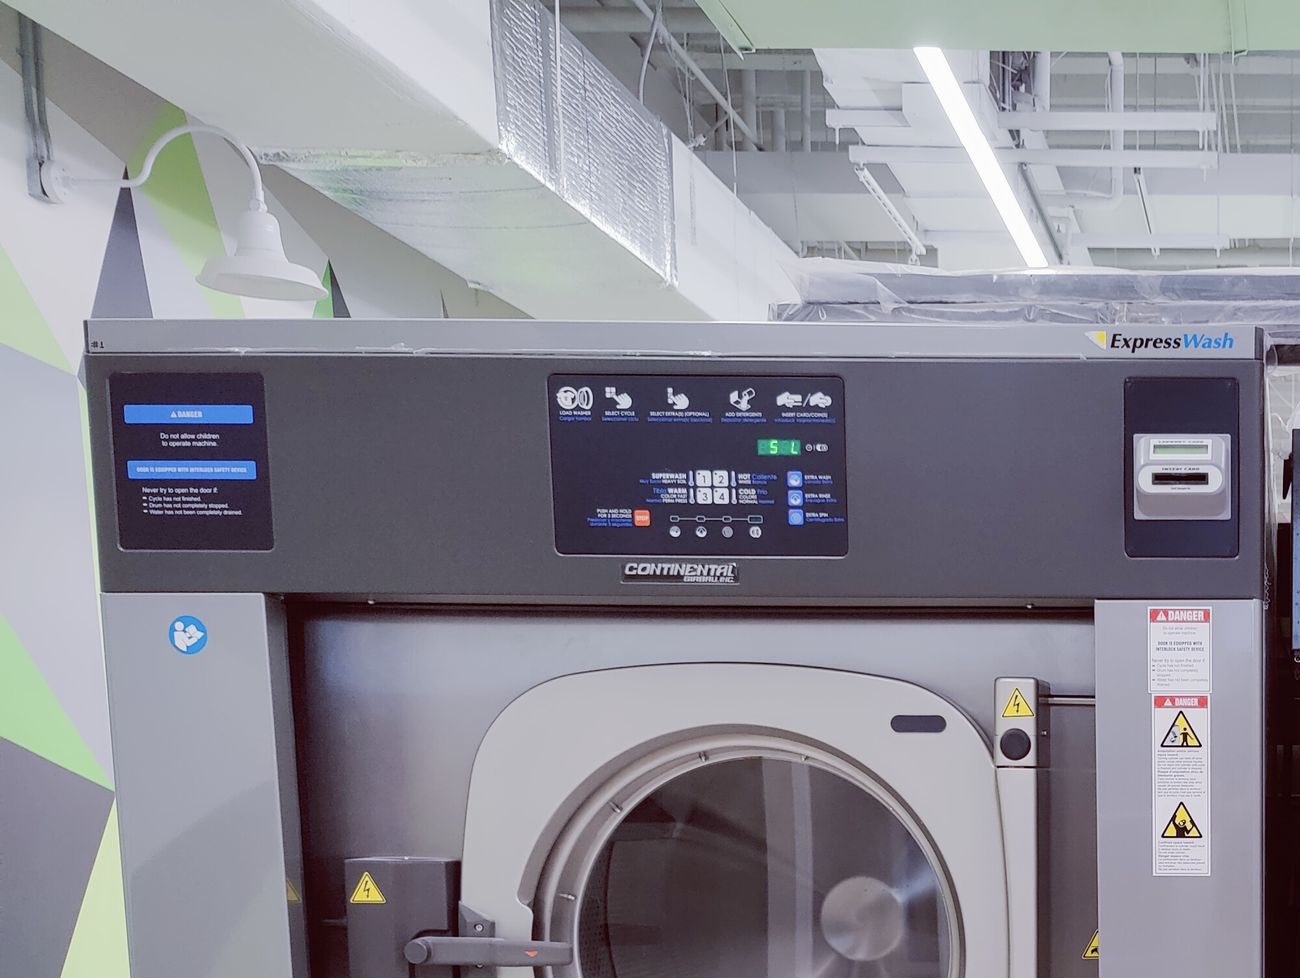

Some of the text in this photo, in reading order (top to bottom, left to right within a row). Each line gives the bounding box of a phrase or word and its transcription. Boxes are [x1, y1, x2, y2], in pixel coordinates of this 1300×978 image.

[1110, 332, 1234, 353] ExpressWash
[160, 432, 169, 440] Do
[702, 492, 725, 501] 3 4
[624, 563, 736, 576] CONTINENTAL
[1168, 610, 1204, 621] DANGER
